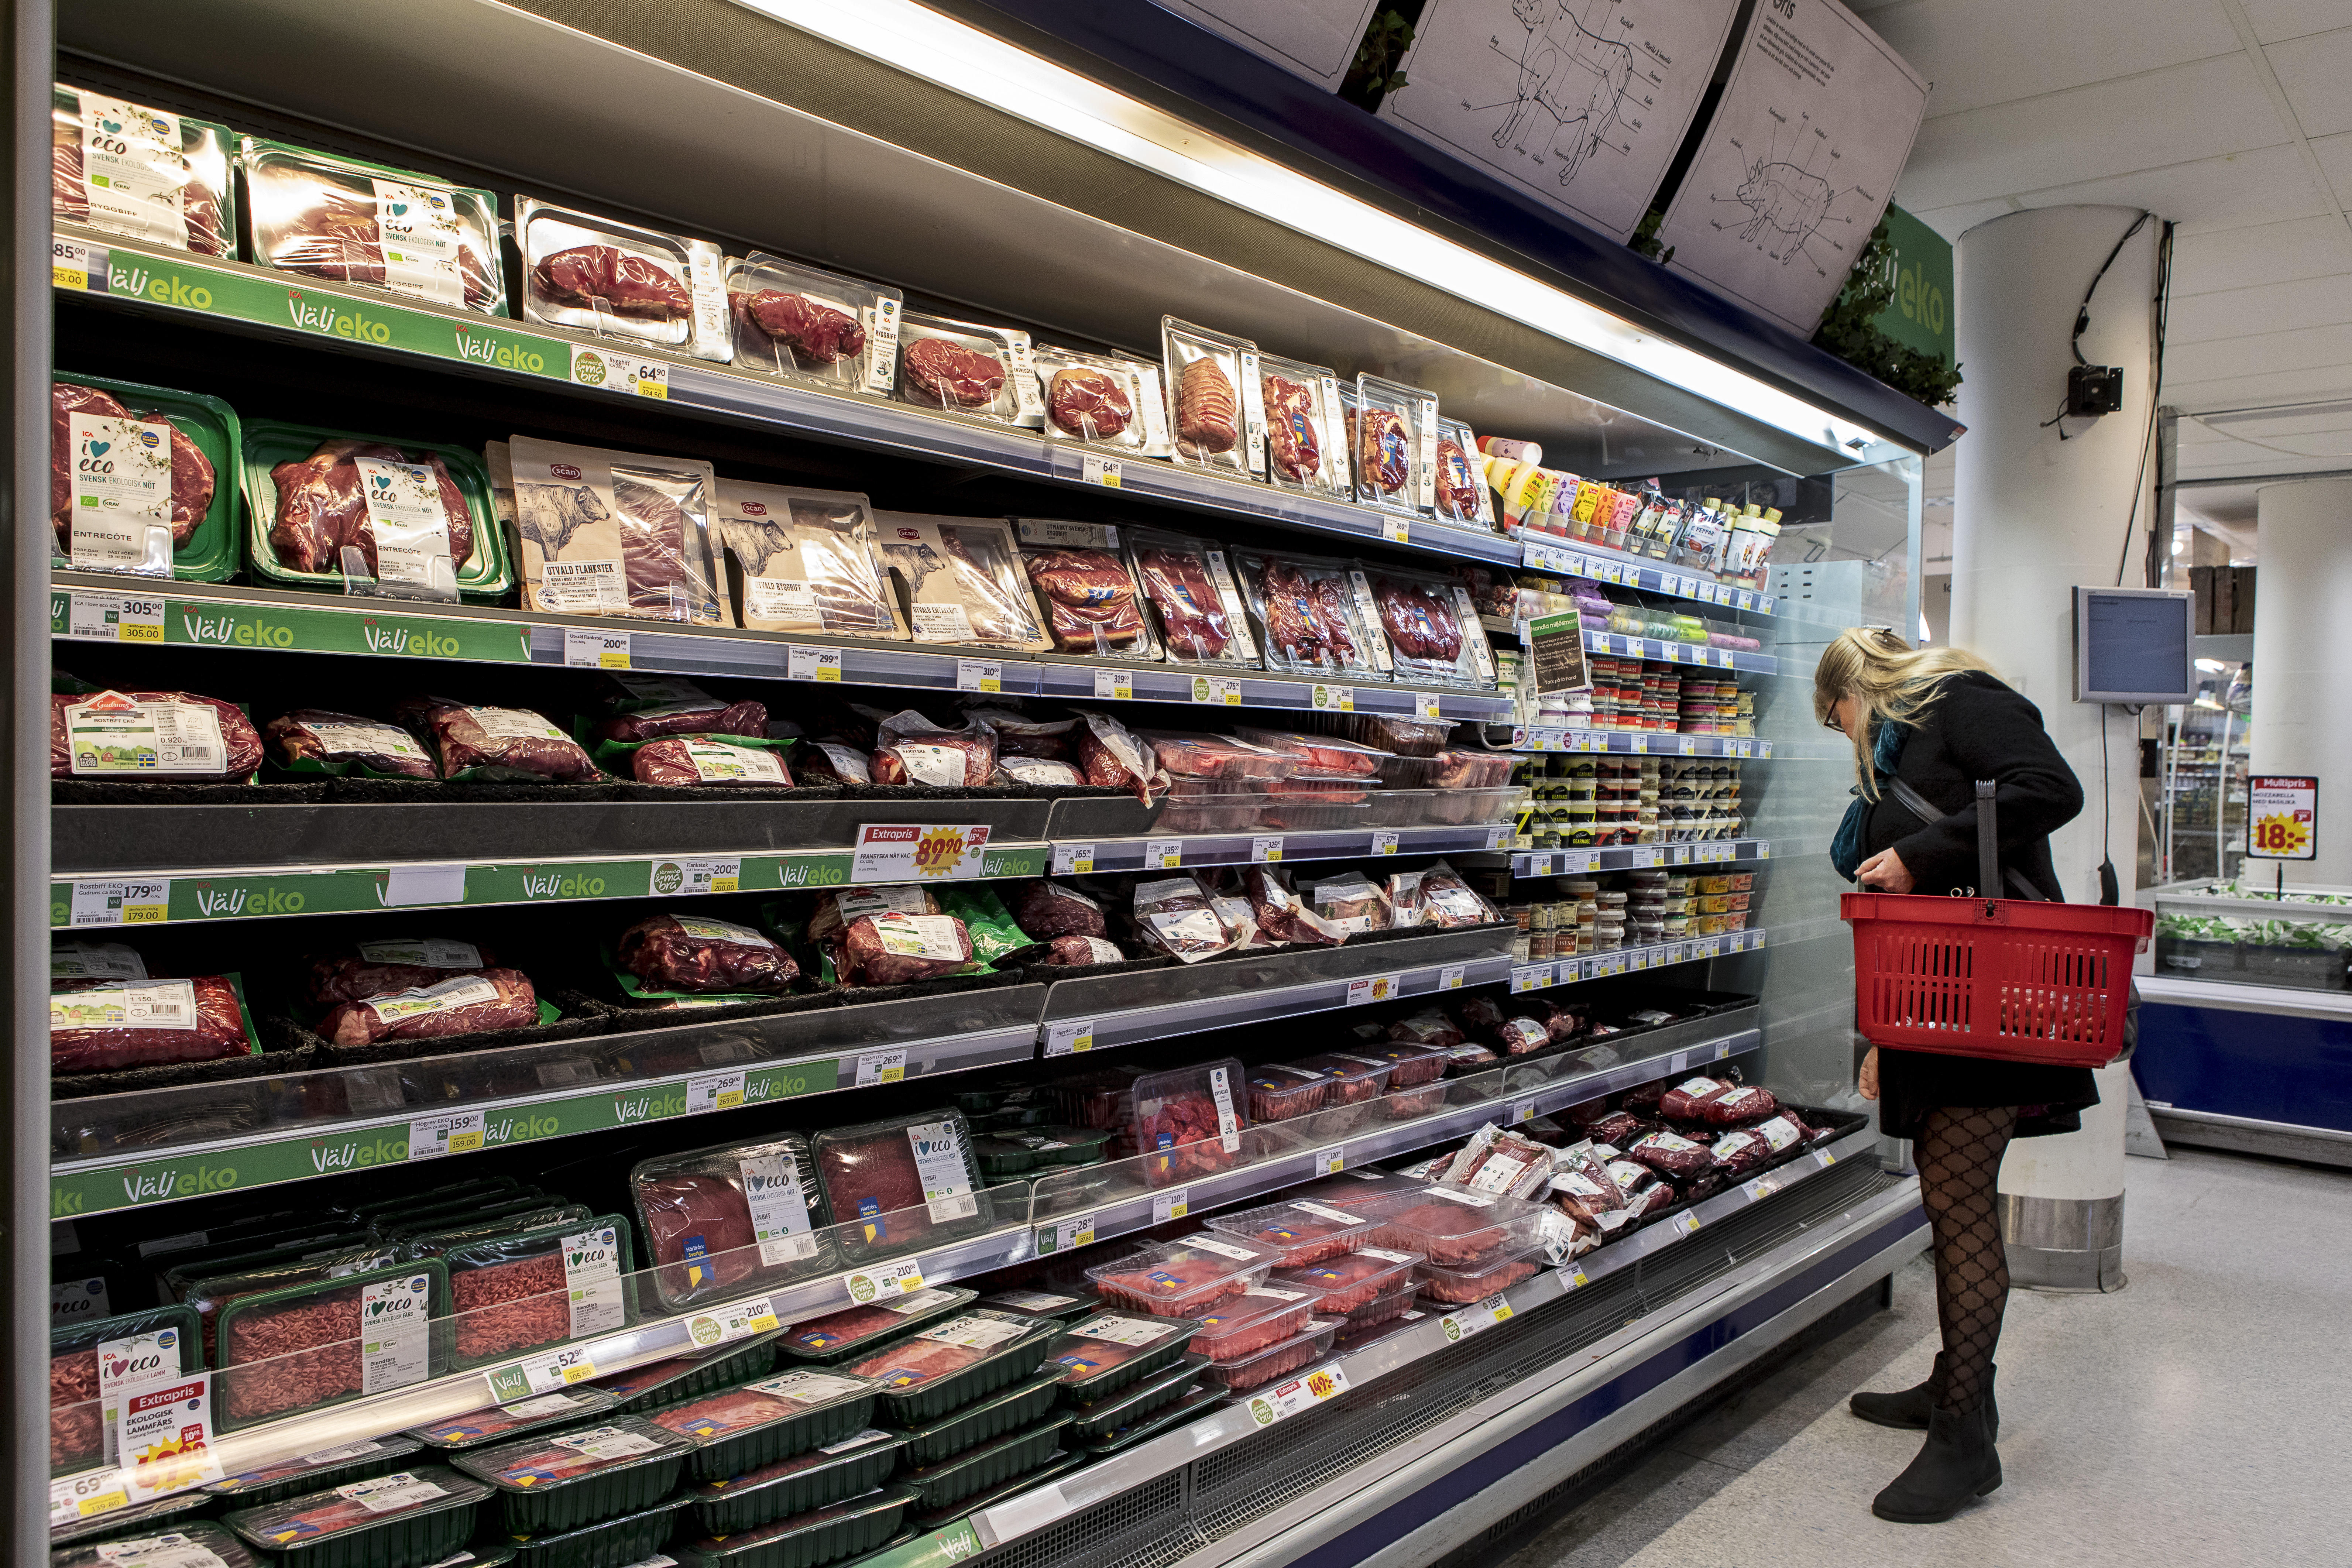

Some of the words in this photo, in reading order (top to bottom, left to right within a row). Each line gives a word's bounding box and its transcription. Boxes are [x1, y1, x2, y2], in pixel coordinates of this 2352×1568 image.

[1490, 35, 1499, 46] Bog
[1461, 98, 1472, 112] Lägg
[92, 136, 127, 155] eco
[1514, 143, 1526, 155] Bringa
[92, 153, 120, 165] SVENSK
[1553, 148, 1570, 162] Fransyska
[91, 202, 138, 217] RYGGBIFF
[385, 233, 407, 242] SVENSK
[408, 236, 435, 246] EKOLOGISK
[435, 240, 446, 248] NÖT
[289, 291, 302, 300] ICA
[875, 330, 897, 340] RYGGBIFF
[610, 357, 630, 367] Ryggbiff
[79, 458, 114, 473] eco
[556, 468, 576, 476] scan
[79, 474, 107, 484] SVENSK
[109, 477, 141, 488] EKOLOGISK
[143, 480, 155, 490] NÖT
[371, 489, 397, 502] eco
[373, 501, 394, 509] SVENSK
[395, 504, 421, 513] EKOLOGISK
[74, 531, 132, 542] ENTRECÔTE
[378, 545, 421, 555] ENTRECÔTE
[546, 565, 574, 575] UTVALD
[576, 564, 614, 573] FLANKSTEK
[755, 580, 775, 590] UTVALD
[776, 583, 801, 592] RYGGBIFF
[1531, 624, 1550, 632] Handla
[1550, 618, 1578, 628] miljösmart!
[126, 629, 159, 638] 305.00
[97, 701, 134, 710] Gudruns
[2264, 779, 2306, 788] Multipris
[872, 829, 913, 840] Extrapris
[128, 912, 158, 920] 179.00
[719, 1096, 738, 1105] 269.00
[453, 1138, 476, 1149] 159.00
[932, 1139, 951, 1152] eco
[766, 1174, 789, 1188] eco
[755, 1213, 771, 1221] LÖVBIFF
[584, 1249, 604, 1263] eco
[583, 1264, 598, 1273] EKOLOGISK
[387, 1297, 412, 1311] eco
[364, 1318, 381, 1327] SVENSK
[381, 1314, 402, 1323] EKOLOGISK
[130, 1355, 160, 1373] eco
[370, 1357, 396, 1366] Blandfärs
[104, 1379, 124, 1389] SVENSK
[125, 1374, 150, 1384] EKOLOGISK
[151, 1369, 166, 1378] LAMM
[569, 1369, 591, 1381] 105.80
[140, 1387, 194, 1408] Extrapris
[1283, 1397, 1296, 1407] LÖVBIFF
[127, 1409, 173, 1426] EKOLOGISK
[127, 1418, 172, 1435] LAMMFÄRS
